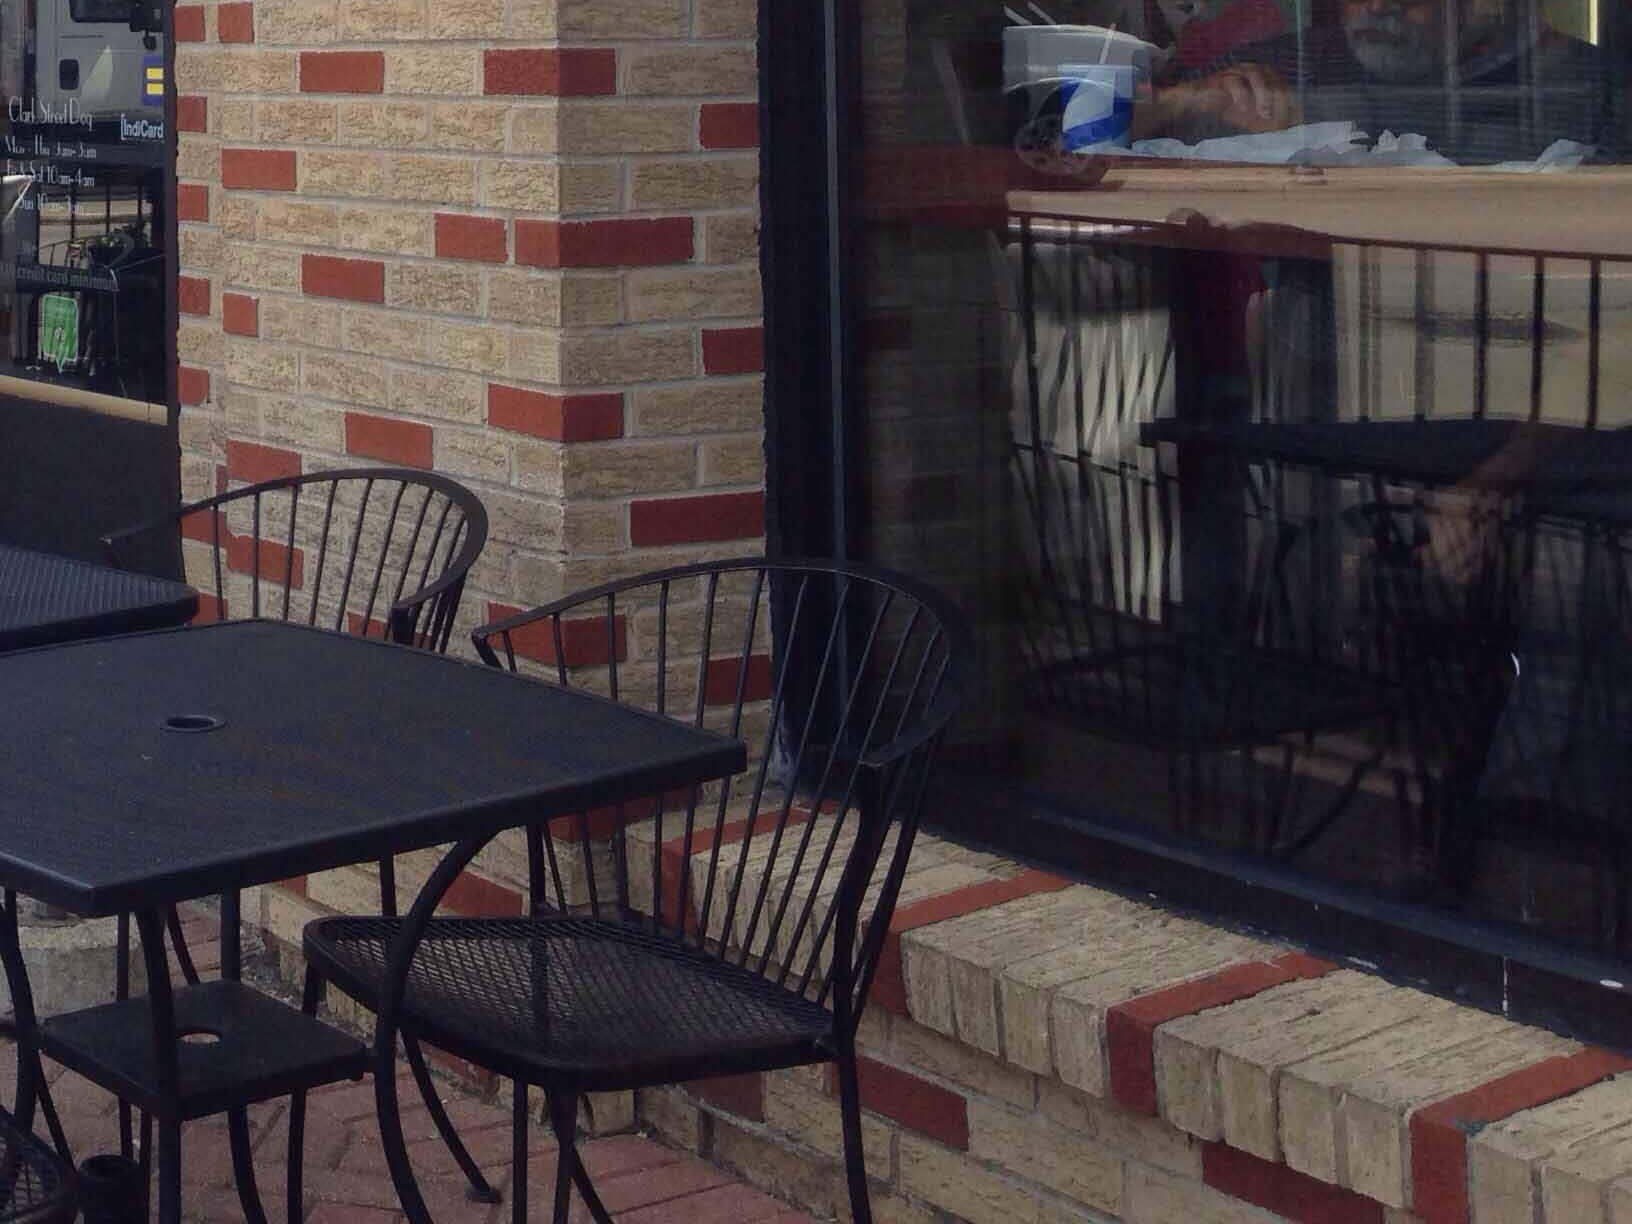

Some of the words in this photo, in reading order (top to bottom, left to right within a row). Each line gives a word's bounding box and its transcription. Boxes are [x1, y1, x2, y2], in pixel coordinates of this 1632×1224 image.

[8, 96, 37, 124] Clark
[39, 97, 68, 125] Street
[69, 97, 94, 131] Dog
